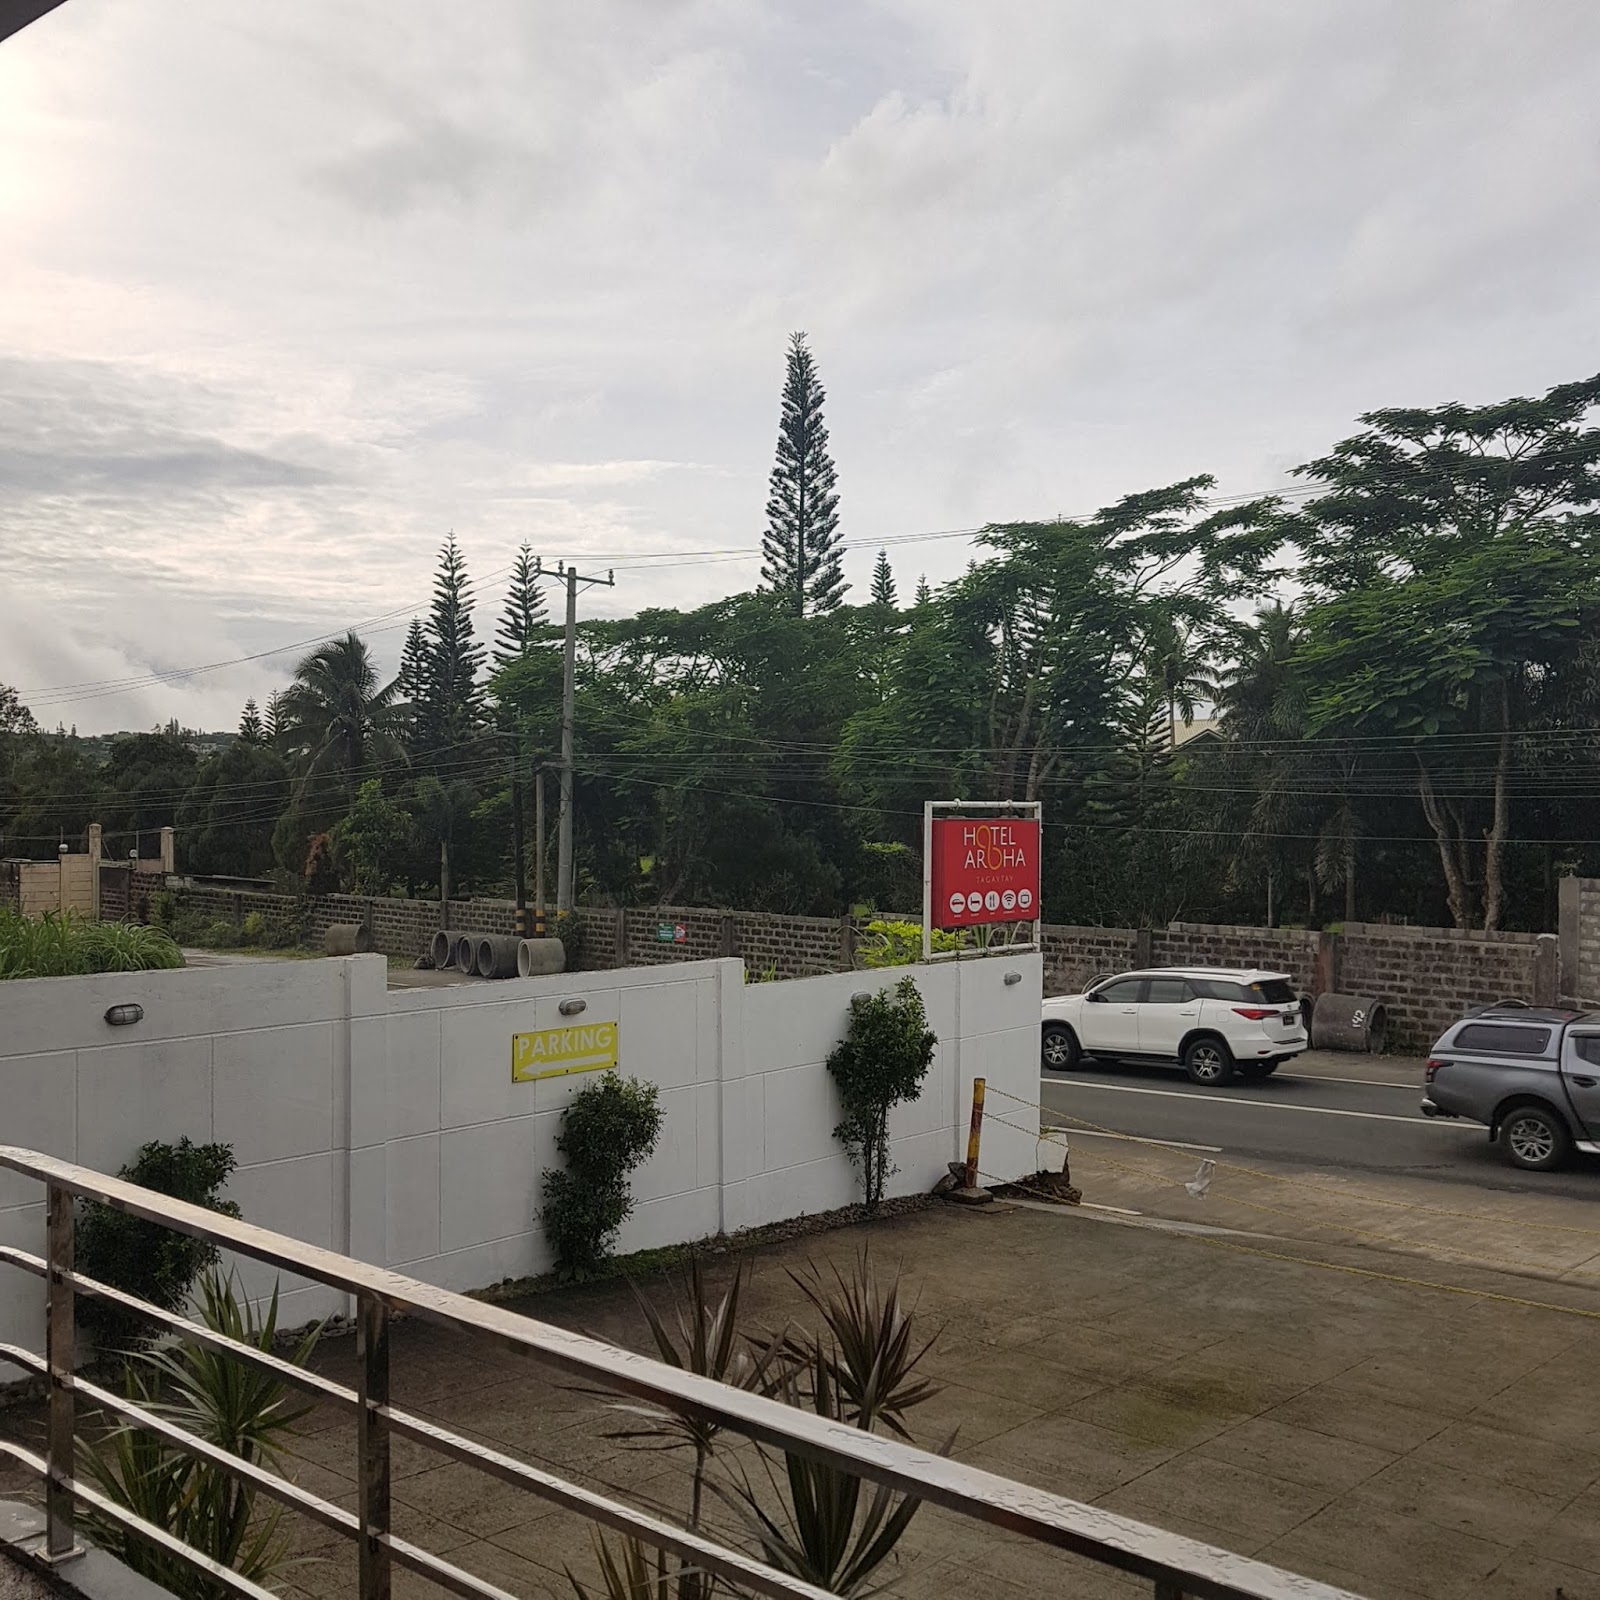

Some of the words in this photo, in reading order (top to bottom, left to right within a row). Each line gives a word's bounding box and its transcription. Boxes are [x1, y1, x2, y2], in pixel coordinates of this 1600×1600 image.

[963, 825, 1016, 848] HOTEL
[964, 847, 1026, 870] AROHA
[976, 875, 1014, 884] TAGAYTAY
[1352, 1009, 1366, 1028] 142
[518, 1027, 612, 1060] PARKING
